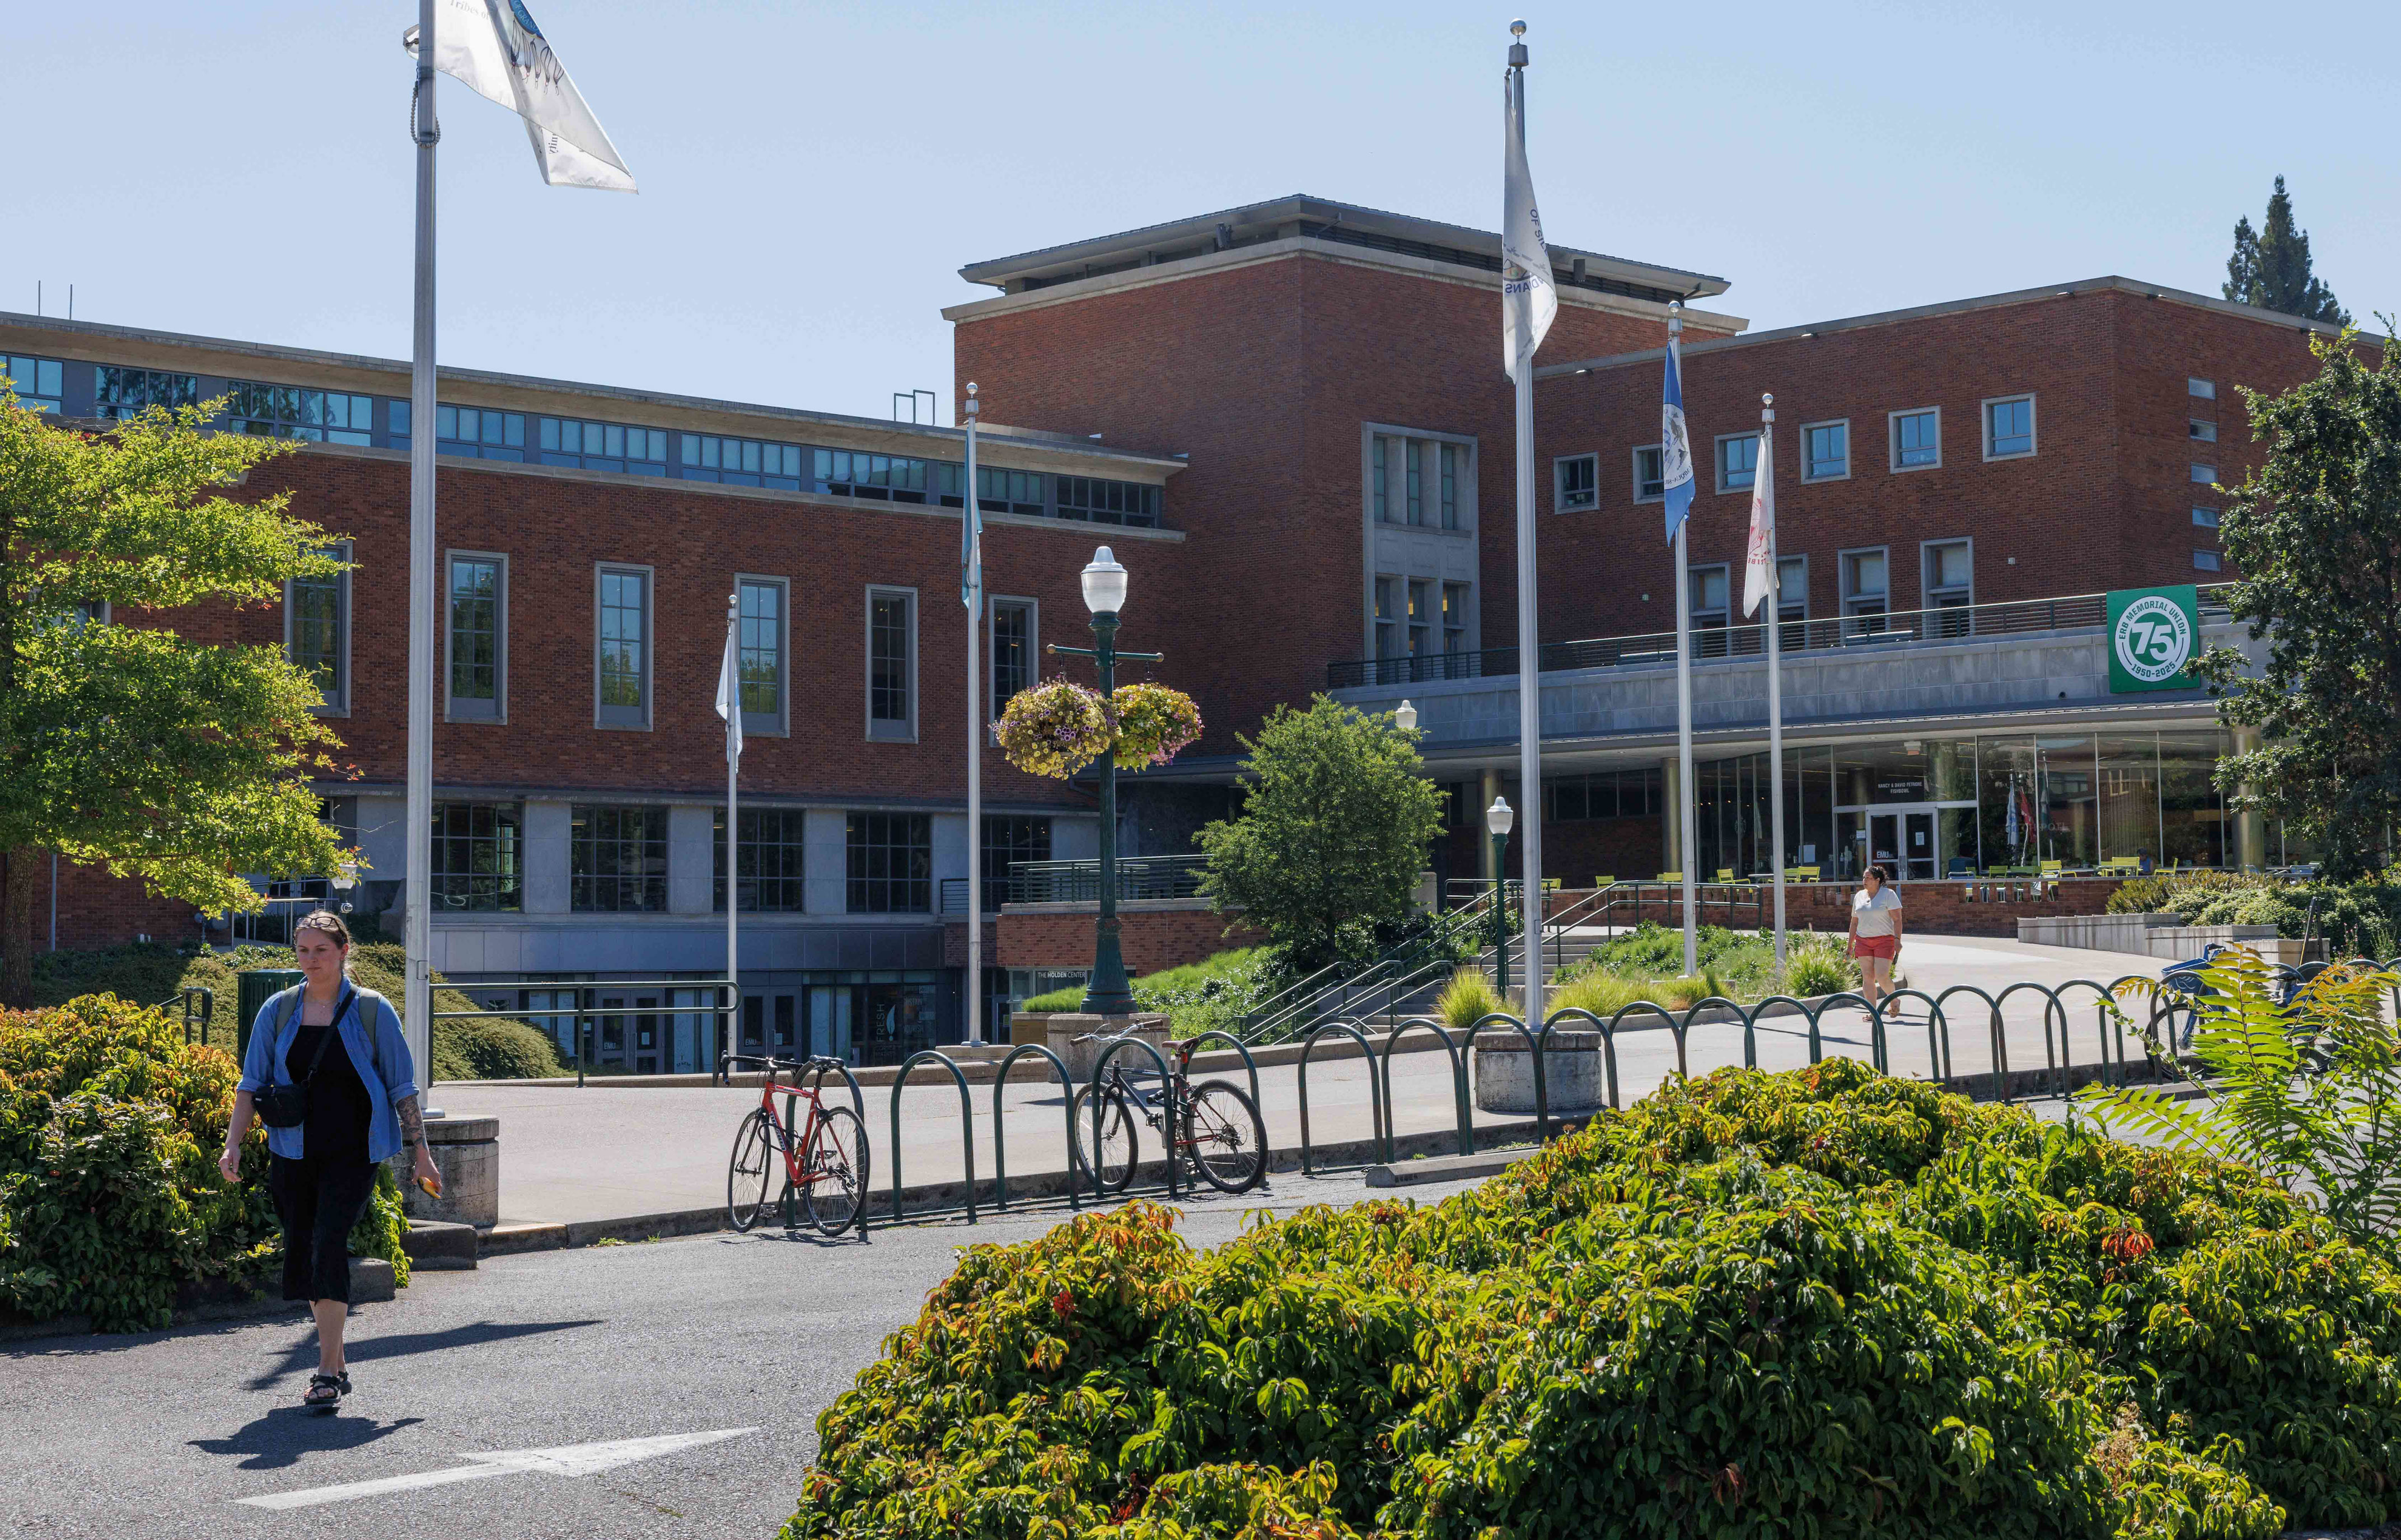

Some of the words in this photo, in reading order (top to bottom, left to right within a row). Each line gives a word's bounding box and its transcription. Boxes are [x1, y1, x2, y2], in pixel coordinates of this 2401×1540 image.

[1530, 209, 1539, 227] OF
[2119, 622, 2129, 639] ERB
[2126, 601, 2168, 621] MEMORIAL
[2169, 607, 2187, 635] UNION
[2132, 621, 2176, 661] 75
[2131, 662, 2176, 677] 1950-2025
[877, 1004, 885, 1042] FRESH
